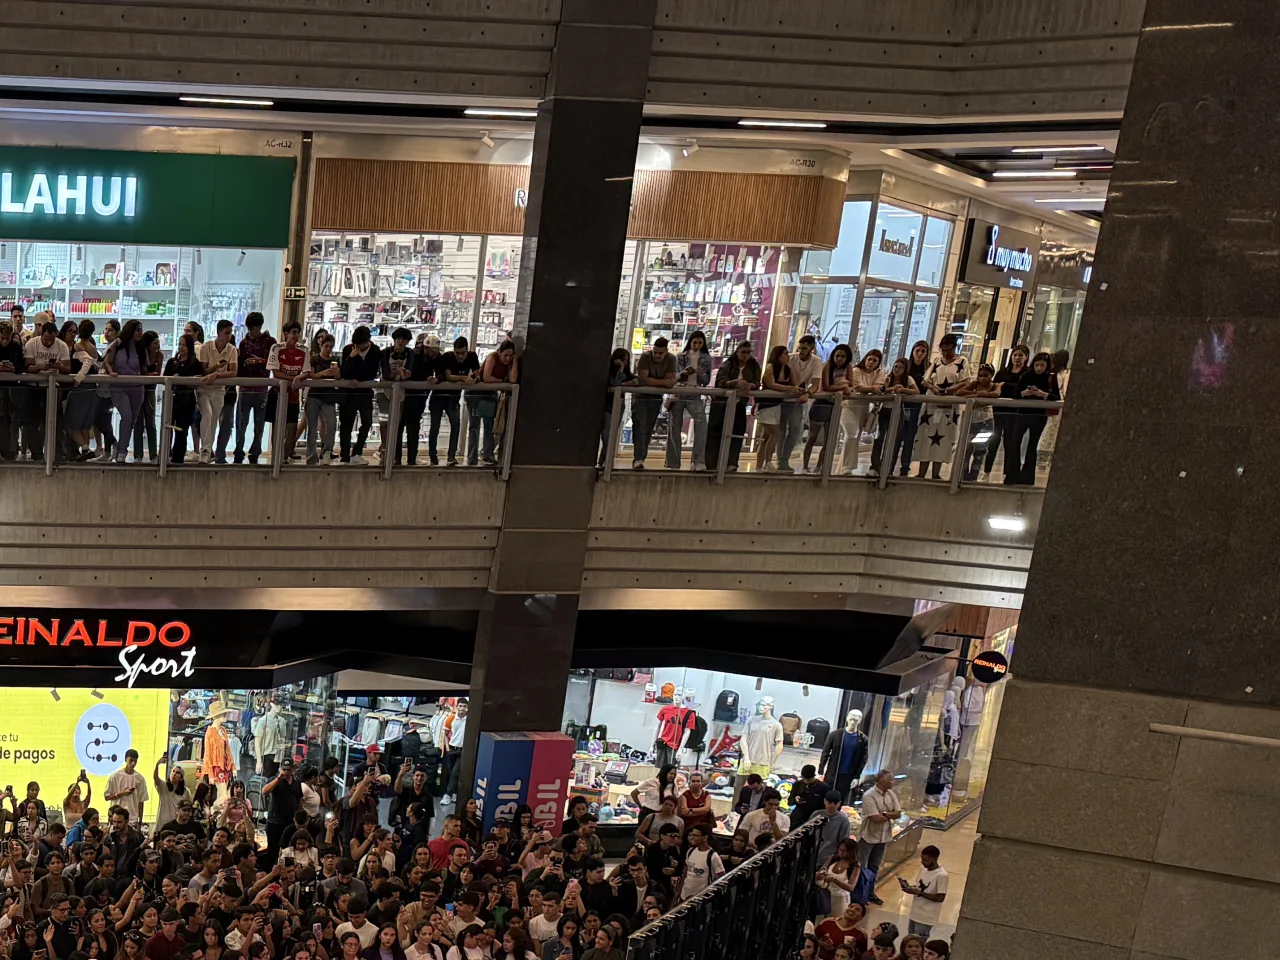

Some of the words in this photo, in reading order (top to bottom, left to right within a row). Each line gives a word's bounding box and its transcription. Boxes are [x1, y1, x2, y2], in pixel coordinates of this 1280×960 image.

[789, 159, 816, 168] AC-R30
[114, 643, 196, 688] Sport
[8, 732, 18, 743] tu
[14, 748, 55, 764] pagos
